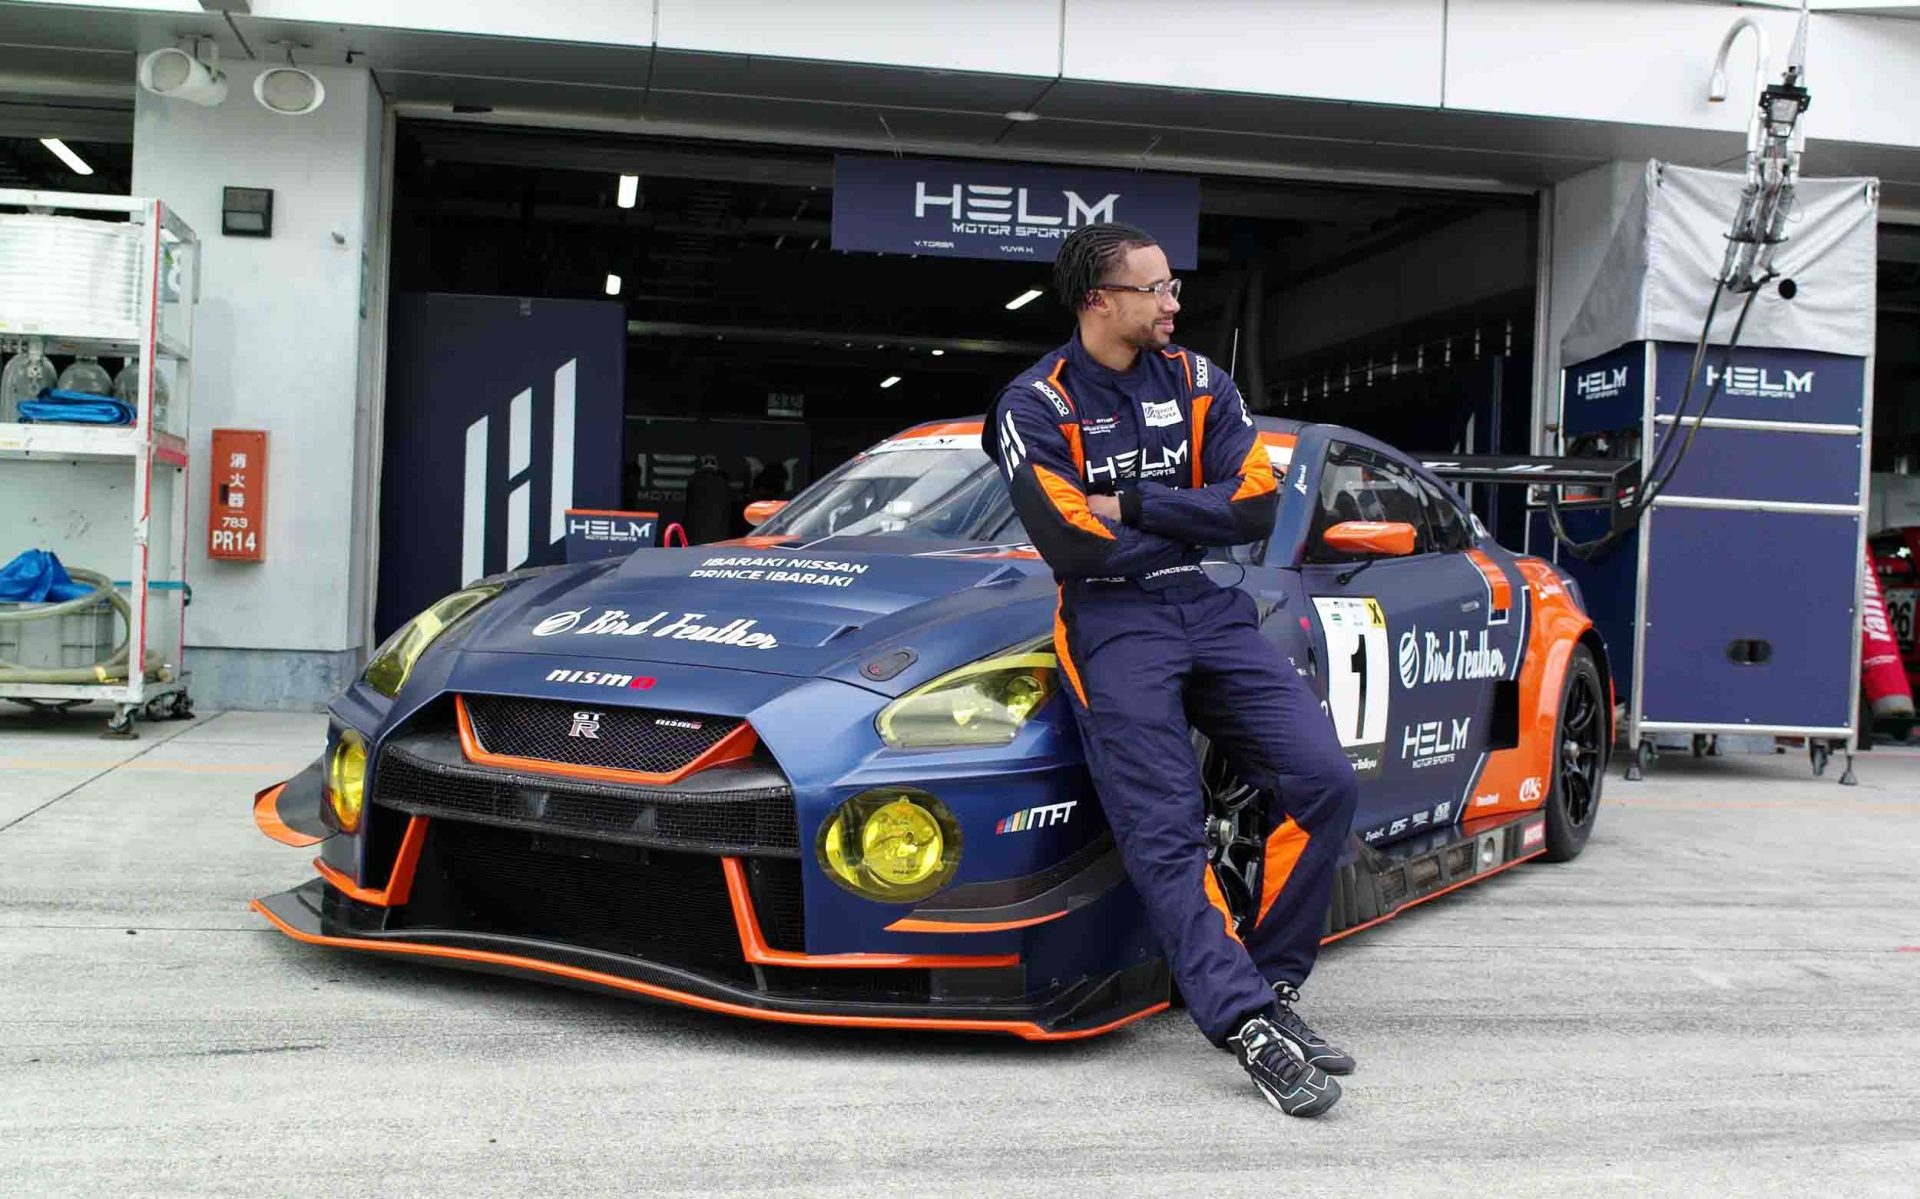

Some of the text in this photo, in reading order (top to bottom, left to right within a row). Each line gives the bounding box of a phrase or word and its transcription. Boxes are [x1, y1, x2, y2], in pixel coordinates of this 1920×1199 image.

[915, 181, 1121, 226] HELM
[952, 223, 1010, 236] MOTOR
[1577, 366, 1628, 396] HELM
[1706, 365, 1816, 393] HELM
[1085, 440, 1188, 483] HELM
[229, 453, 247, 508] 消火器
[1140, 467, 1176, 479] SPORTS
[222, 517, 248, 528] 783
[570, 519, 652, 538] HELM
[212, 530, 257, 552] PR14
[702, 557, 869, 574] IBARAKI NISSAN
[689, 569, 854, 587] PRINCE IBARAKI
[1368, 602, 1382, 624] X
[576, 610, 779, 650] Bird Feather
[1423, 629, 1506, 684] Bird Feather
[545, 668, 657, 691] nismo
[1351, 633, 1367, 740] 1
[573, 711, 606, 721] GT
[568, 720, 600, 739] R
[1402, 717, 1471, 759] HELM
